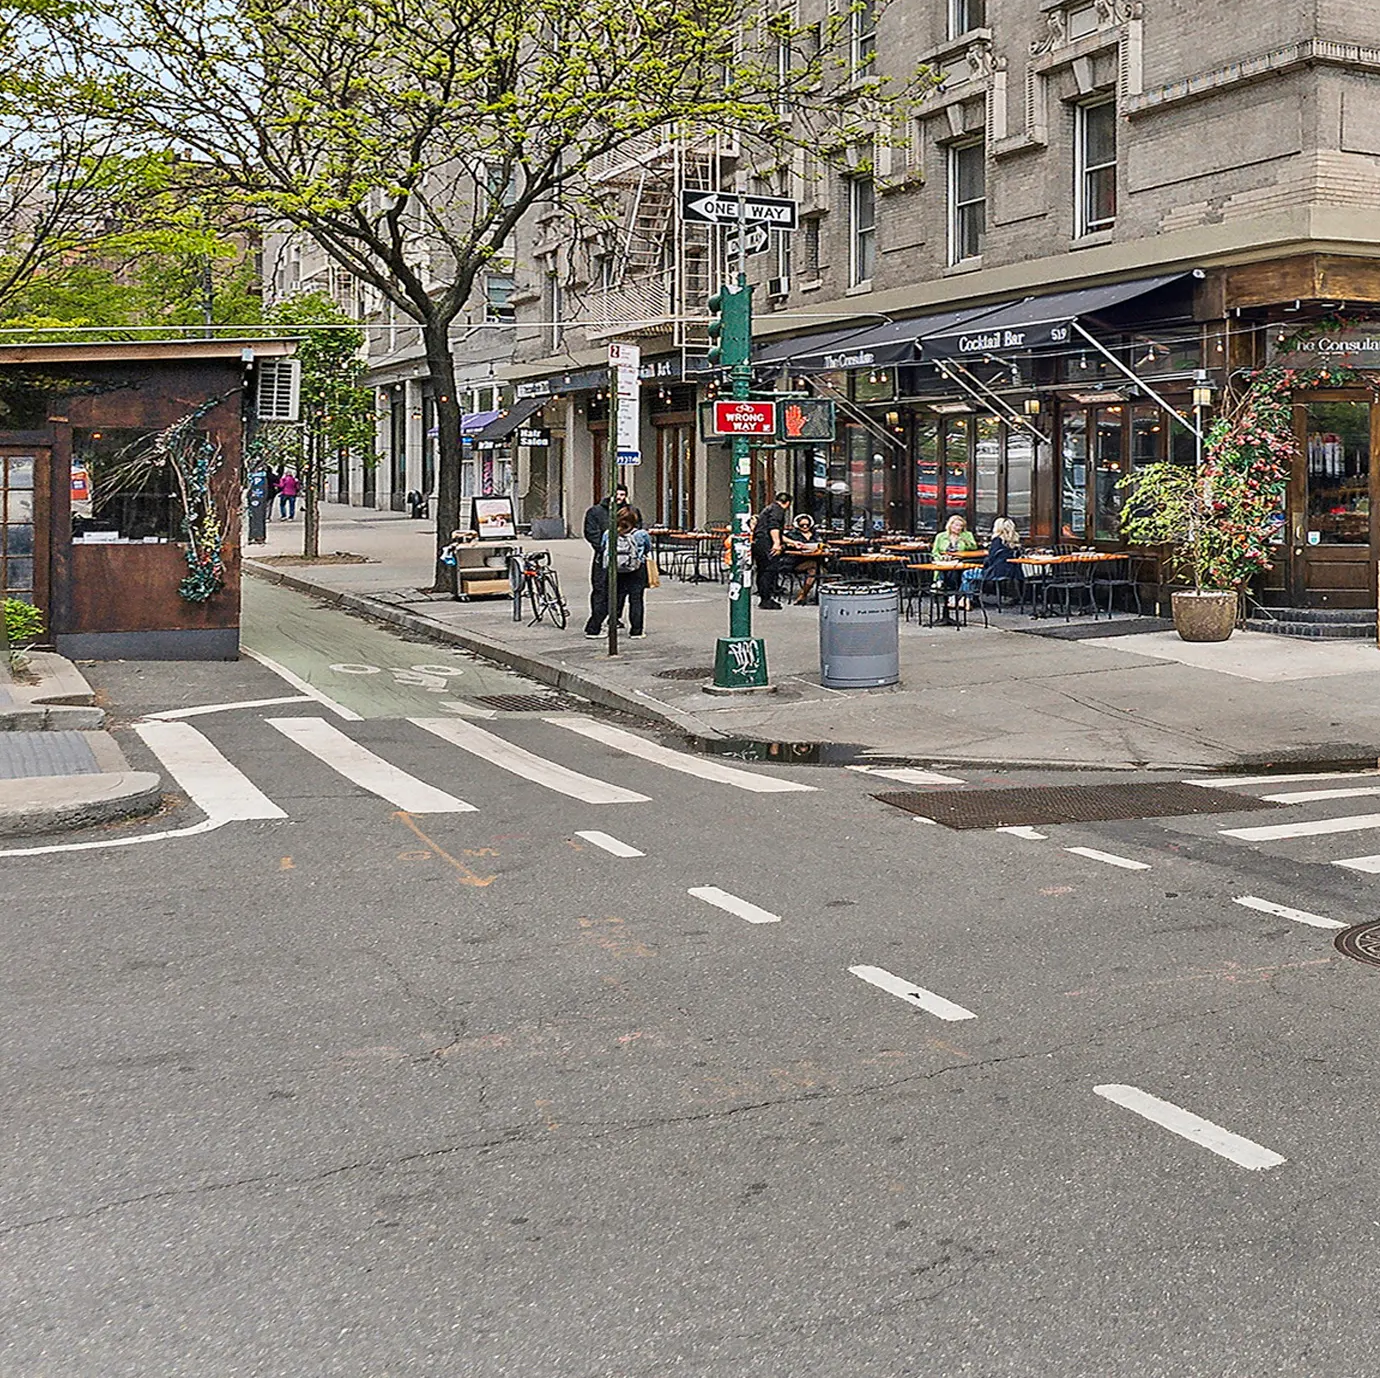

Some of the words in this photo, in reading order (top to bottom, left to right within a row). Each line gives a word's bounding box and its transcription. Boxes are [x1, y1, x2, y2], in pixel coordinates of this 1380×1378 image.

[704, 201, 735, 215] ONE
[752, 206, 784, 219] WAY
[959, 331, 1001, 352] Cocktail
[1004, 330, 1026, 347] Bar
[725, 413, 764, 422] WRONG
[733, 422, 757, 431] WAY
[520, 436, 549, 446] Salon
